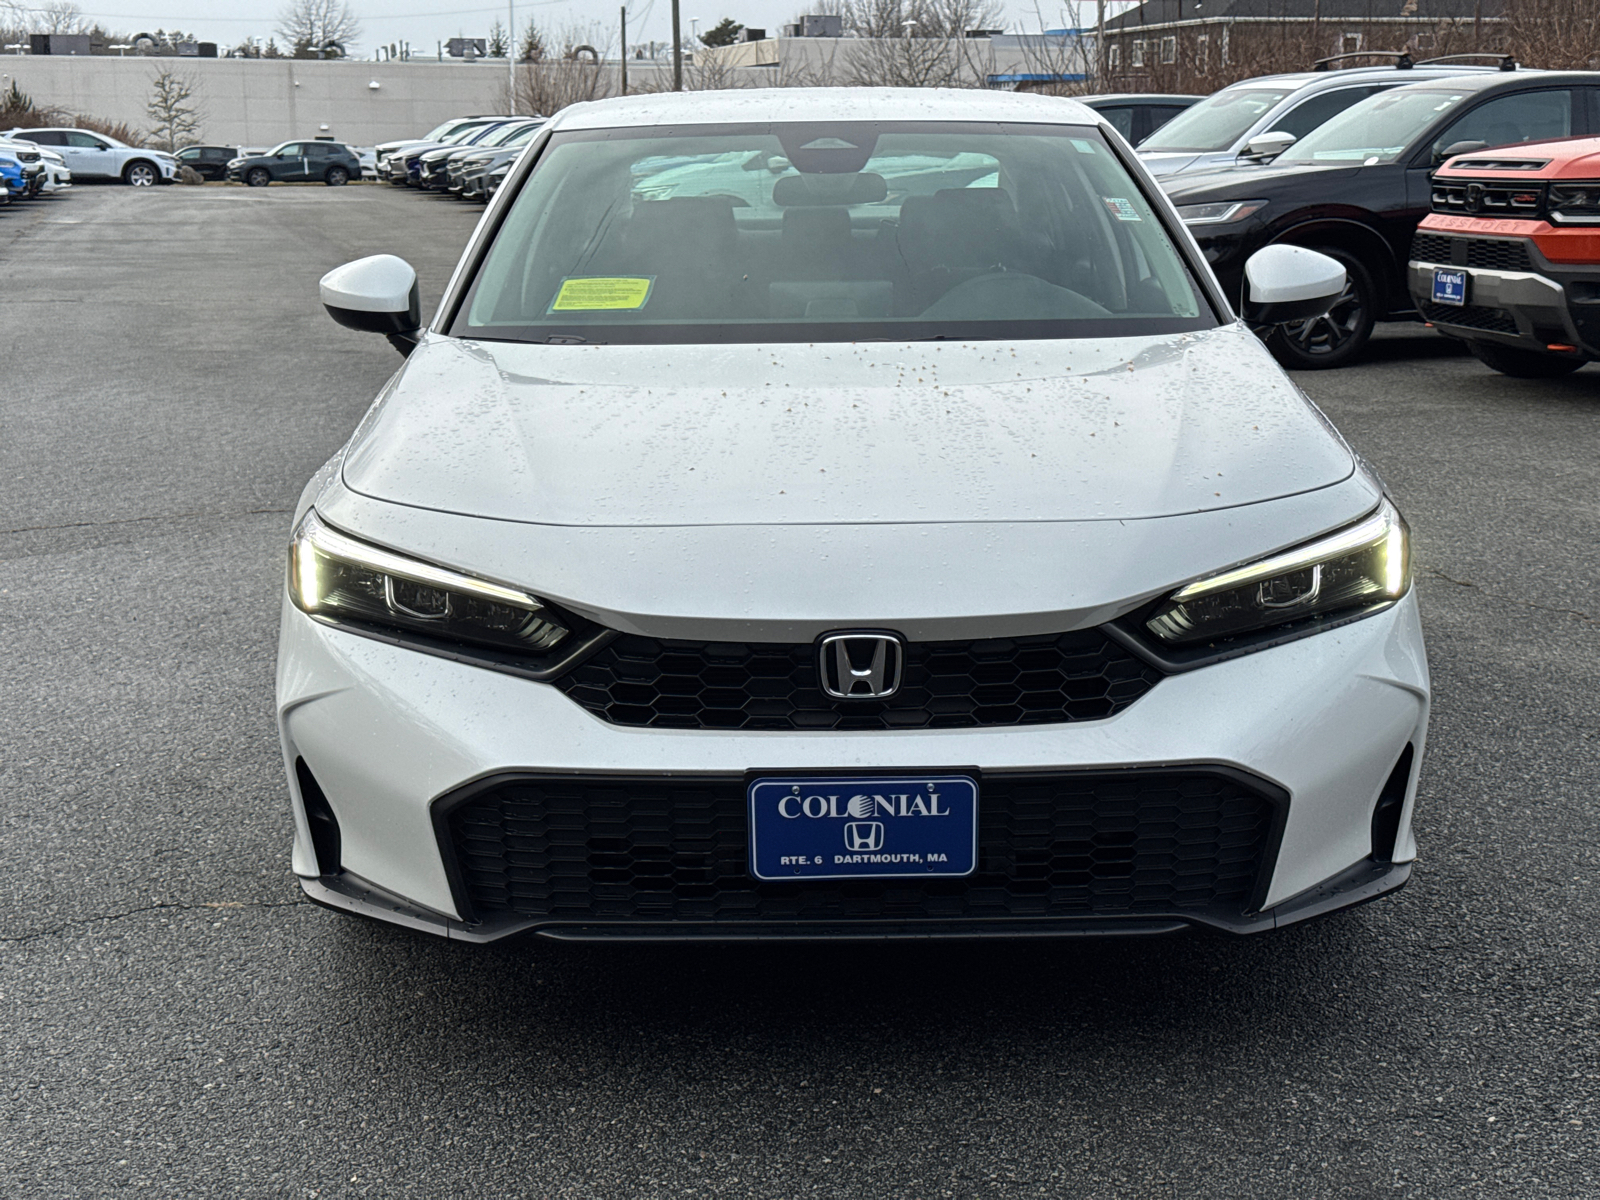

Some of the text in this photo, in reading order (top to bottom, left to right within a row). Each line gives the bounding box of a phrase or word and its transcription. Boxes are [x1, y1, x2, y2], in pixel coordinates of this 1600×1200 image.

[778, 793, 950, 819] COLONIAL
[780, 853, 948, 865] RTE. 6 DARTMOUTH, MA
